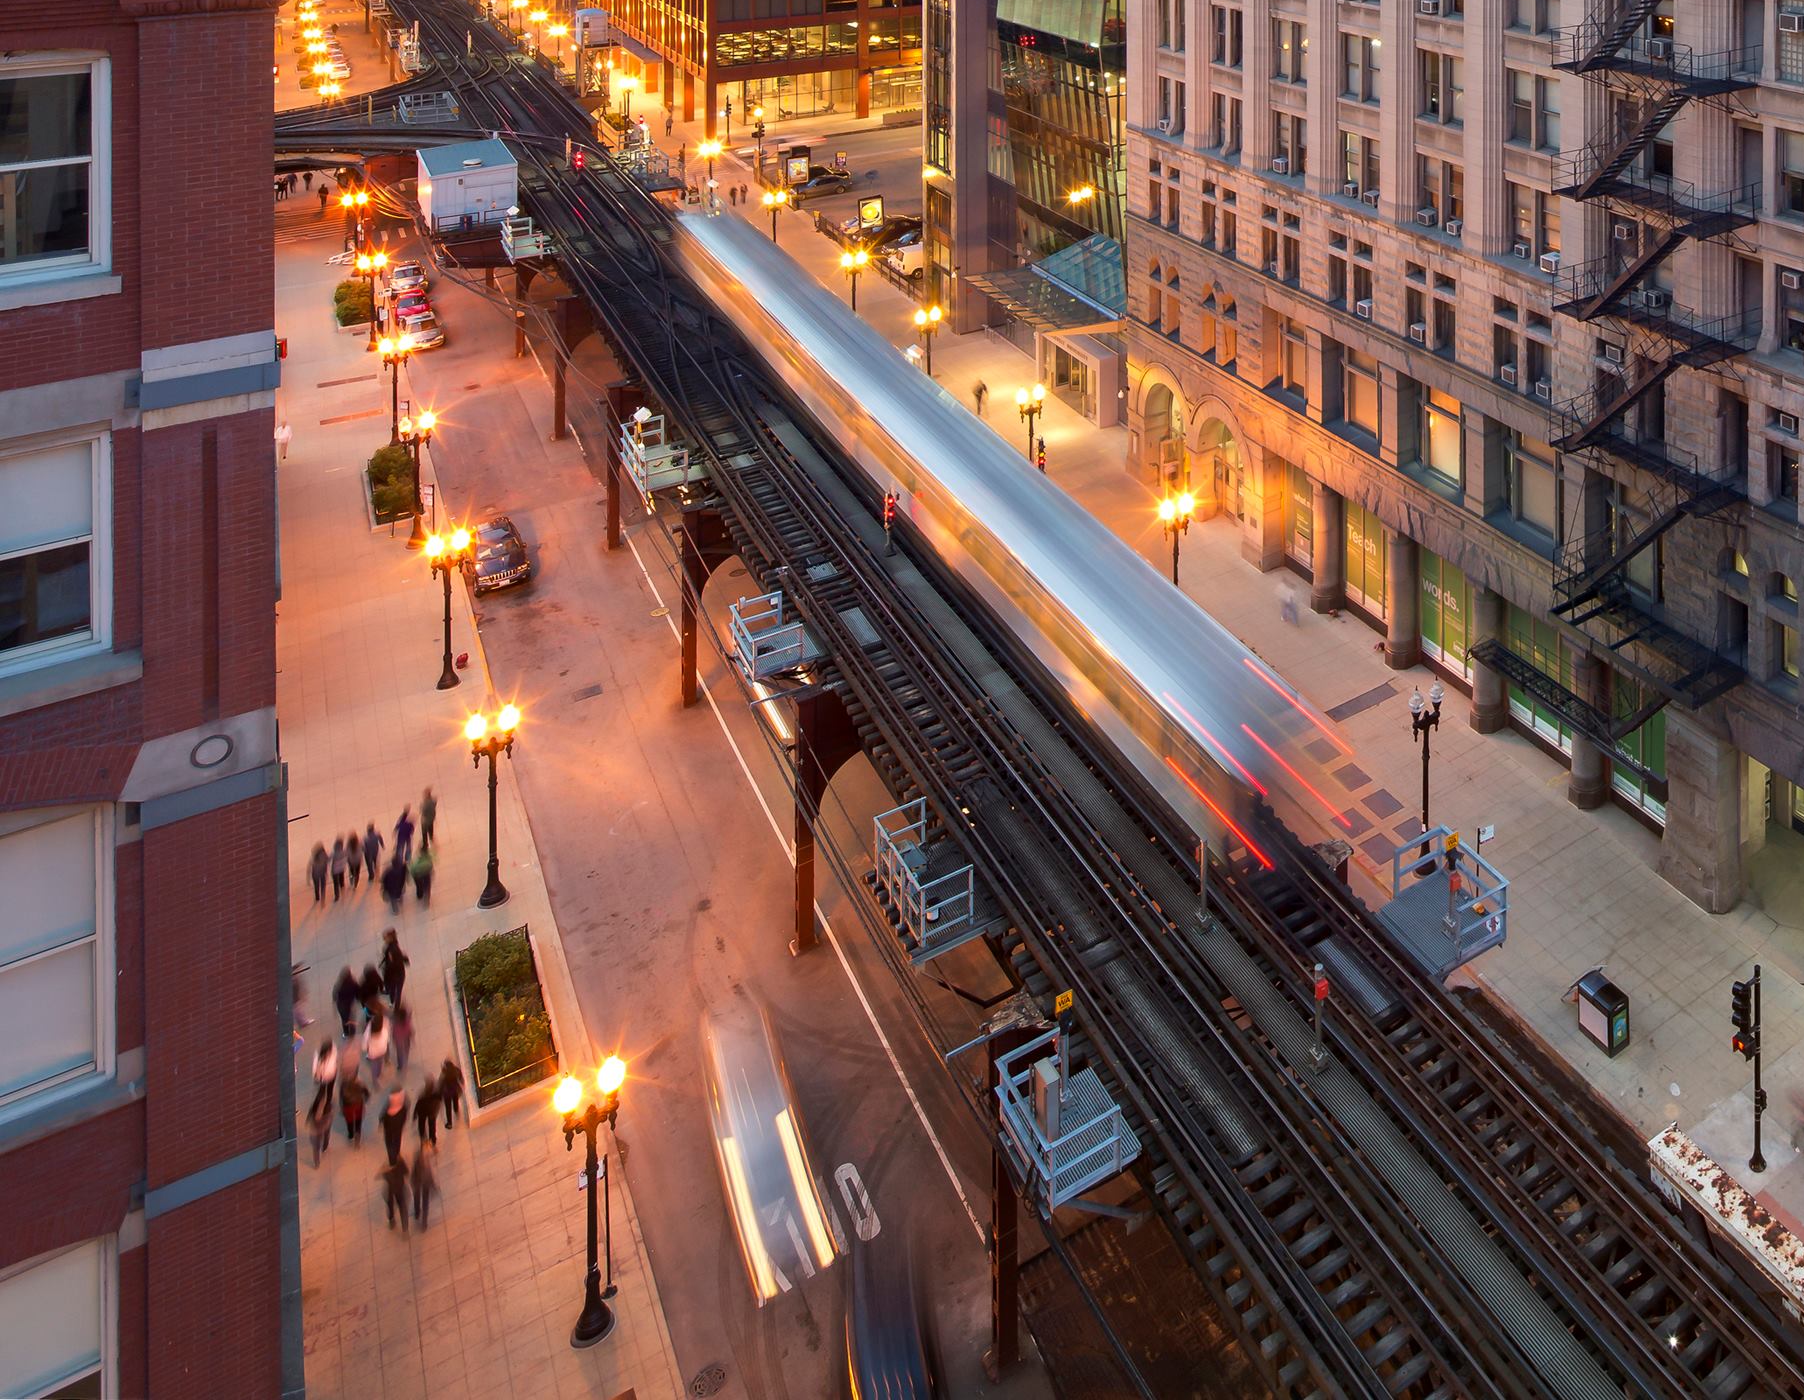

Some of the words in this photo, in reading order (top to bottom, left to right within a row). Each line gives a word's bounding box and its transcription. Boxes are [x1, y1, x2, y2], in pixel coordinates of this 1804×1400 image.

[1347, 523, 1377, 556] Teach
[1422, 579, 1460, 612] words.
[1058, 997, 1070, 1007] WA
